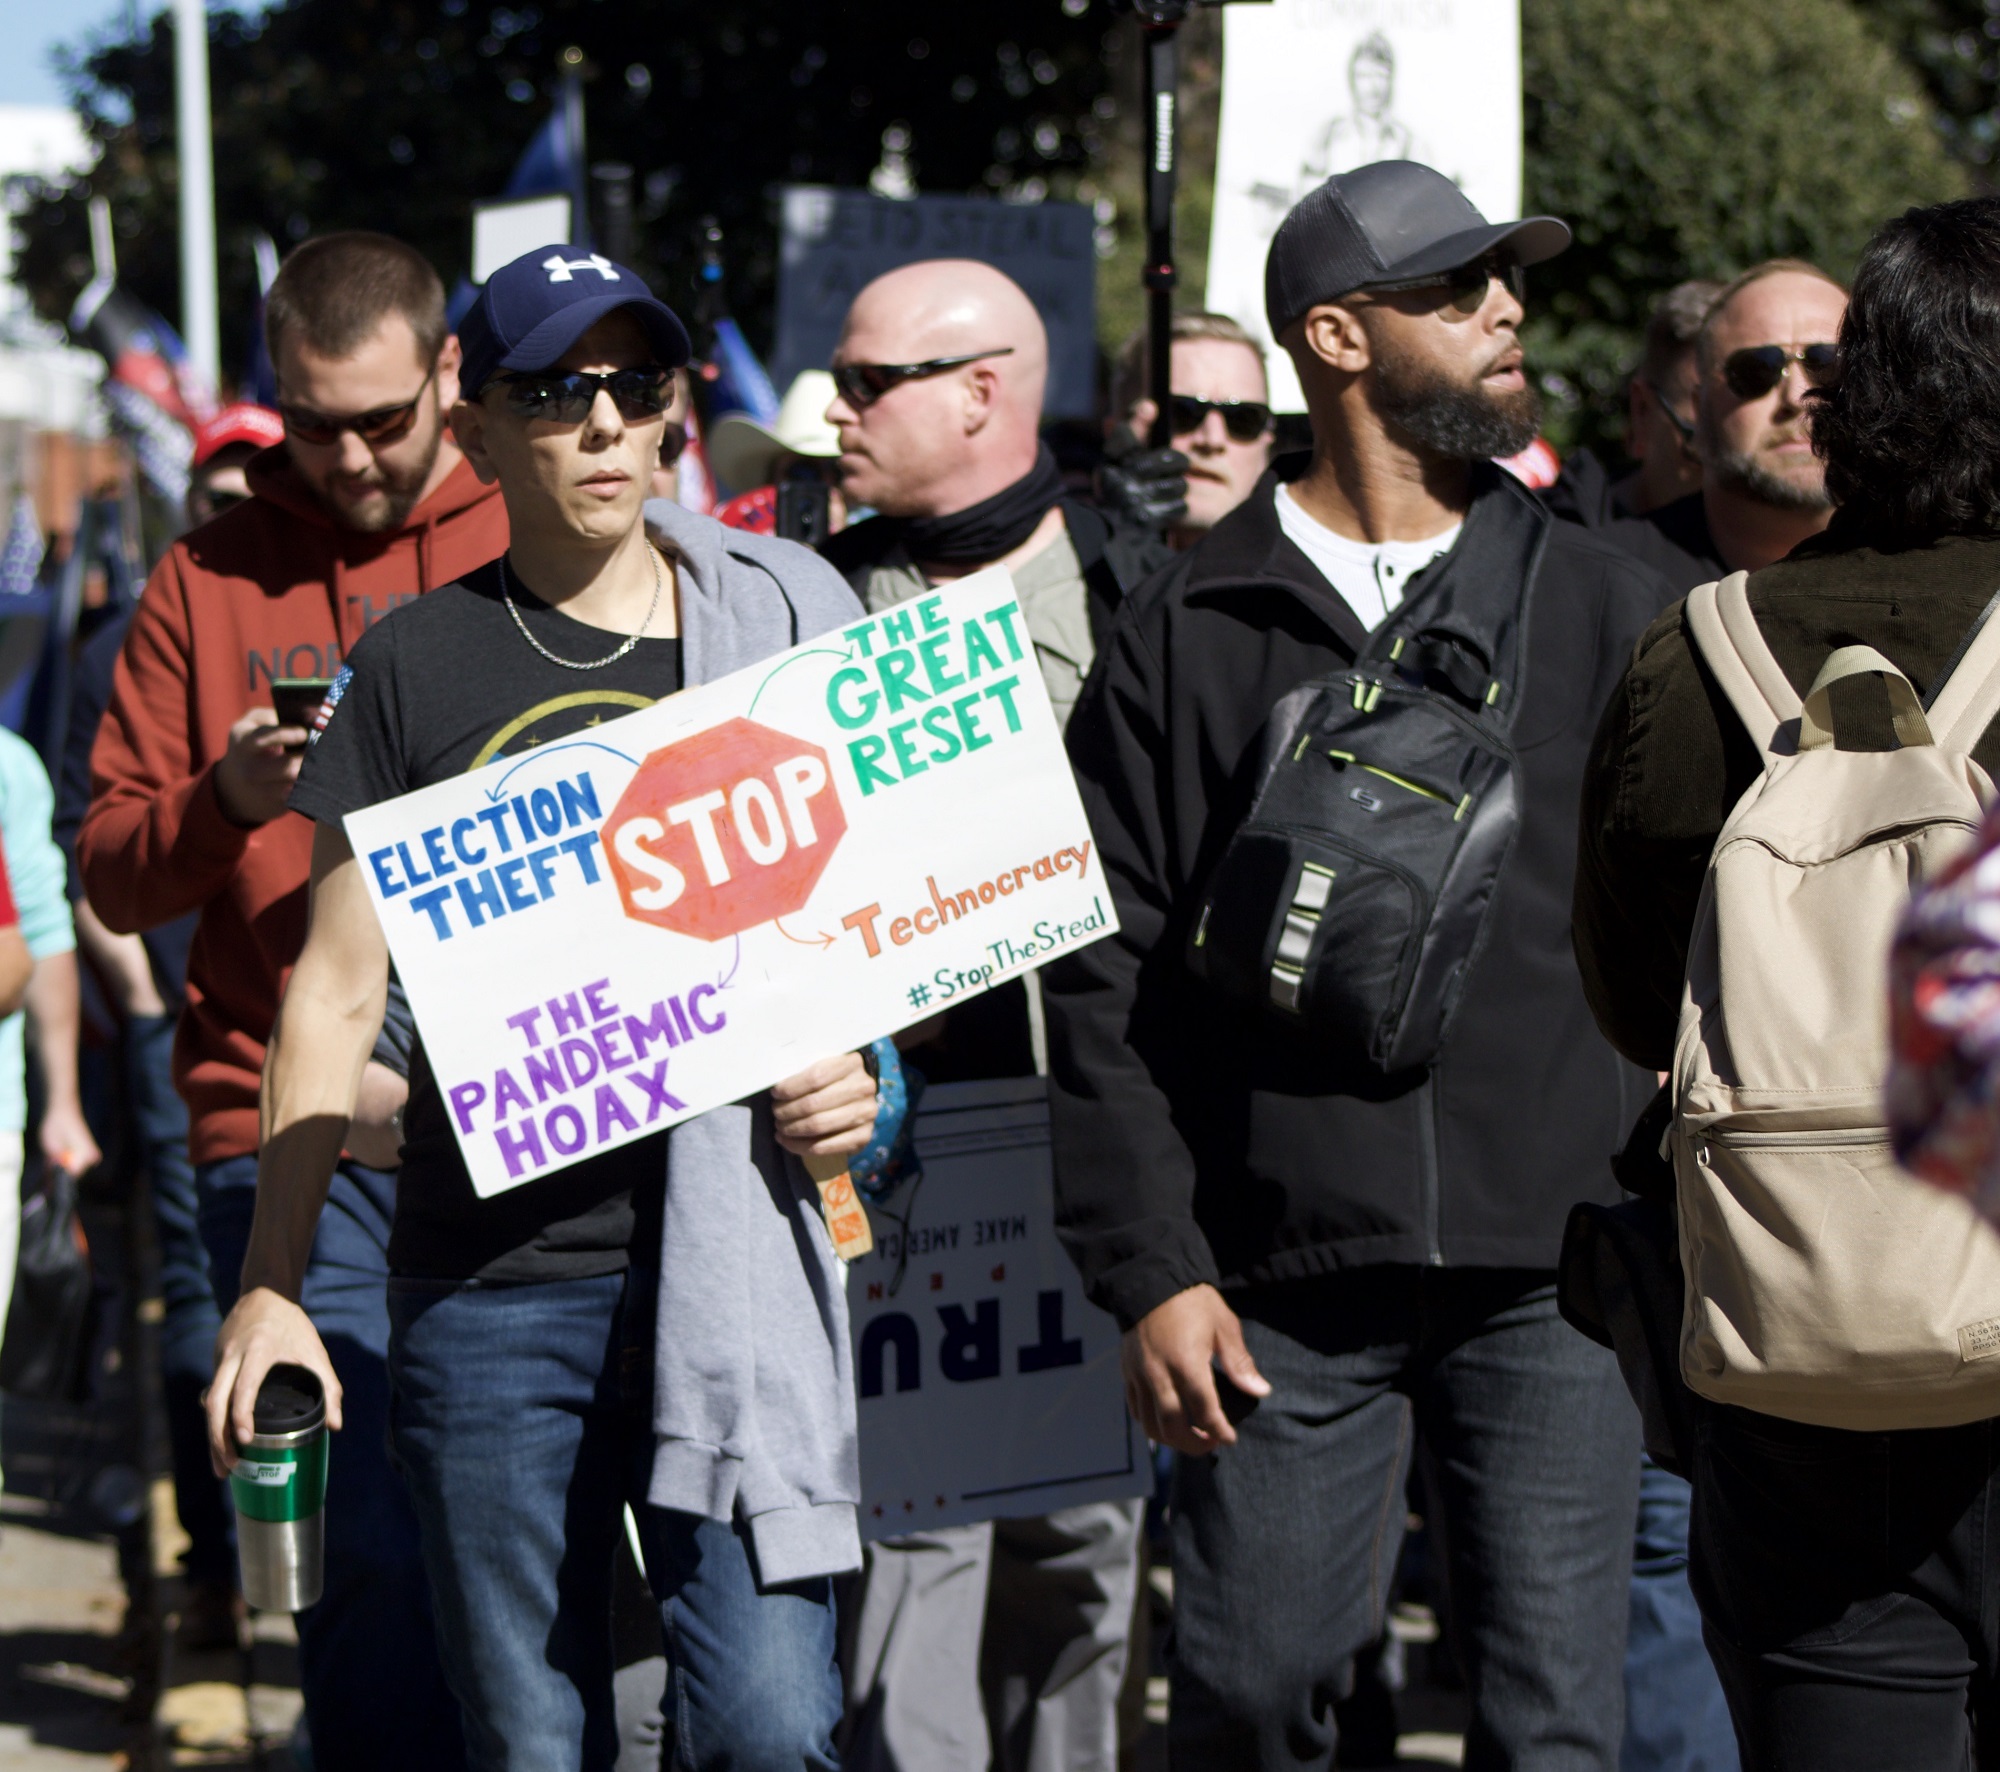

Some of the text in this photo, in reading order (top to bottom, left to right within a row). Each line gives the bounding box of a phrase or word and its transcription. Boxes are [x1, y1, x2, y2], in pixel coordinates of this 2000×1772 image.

[826, 600, 1024, 730] GREAT
[844, 596, 949, 658] THE
[847, 675, 1022, 797] RESET
[368, 772, 603, 898] ELECTION
[410, 830, 601, 941] THEFT
[614, 755, 827, 911] STOP
[843, 840, 1091, 958] Technocracy
[448, 983, 727, 1135] PANDEMIC
[508, 978, 620, 1048] THE
[494, 1059, 687, 1178] HOAX
[877, 1223, 960, 1259] AMERCA
[974, 1214, 1027, 1247] MAKE
